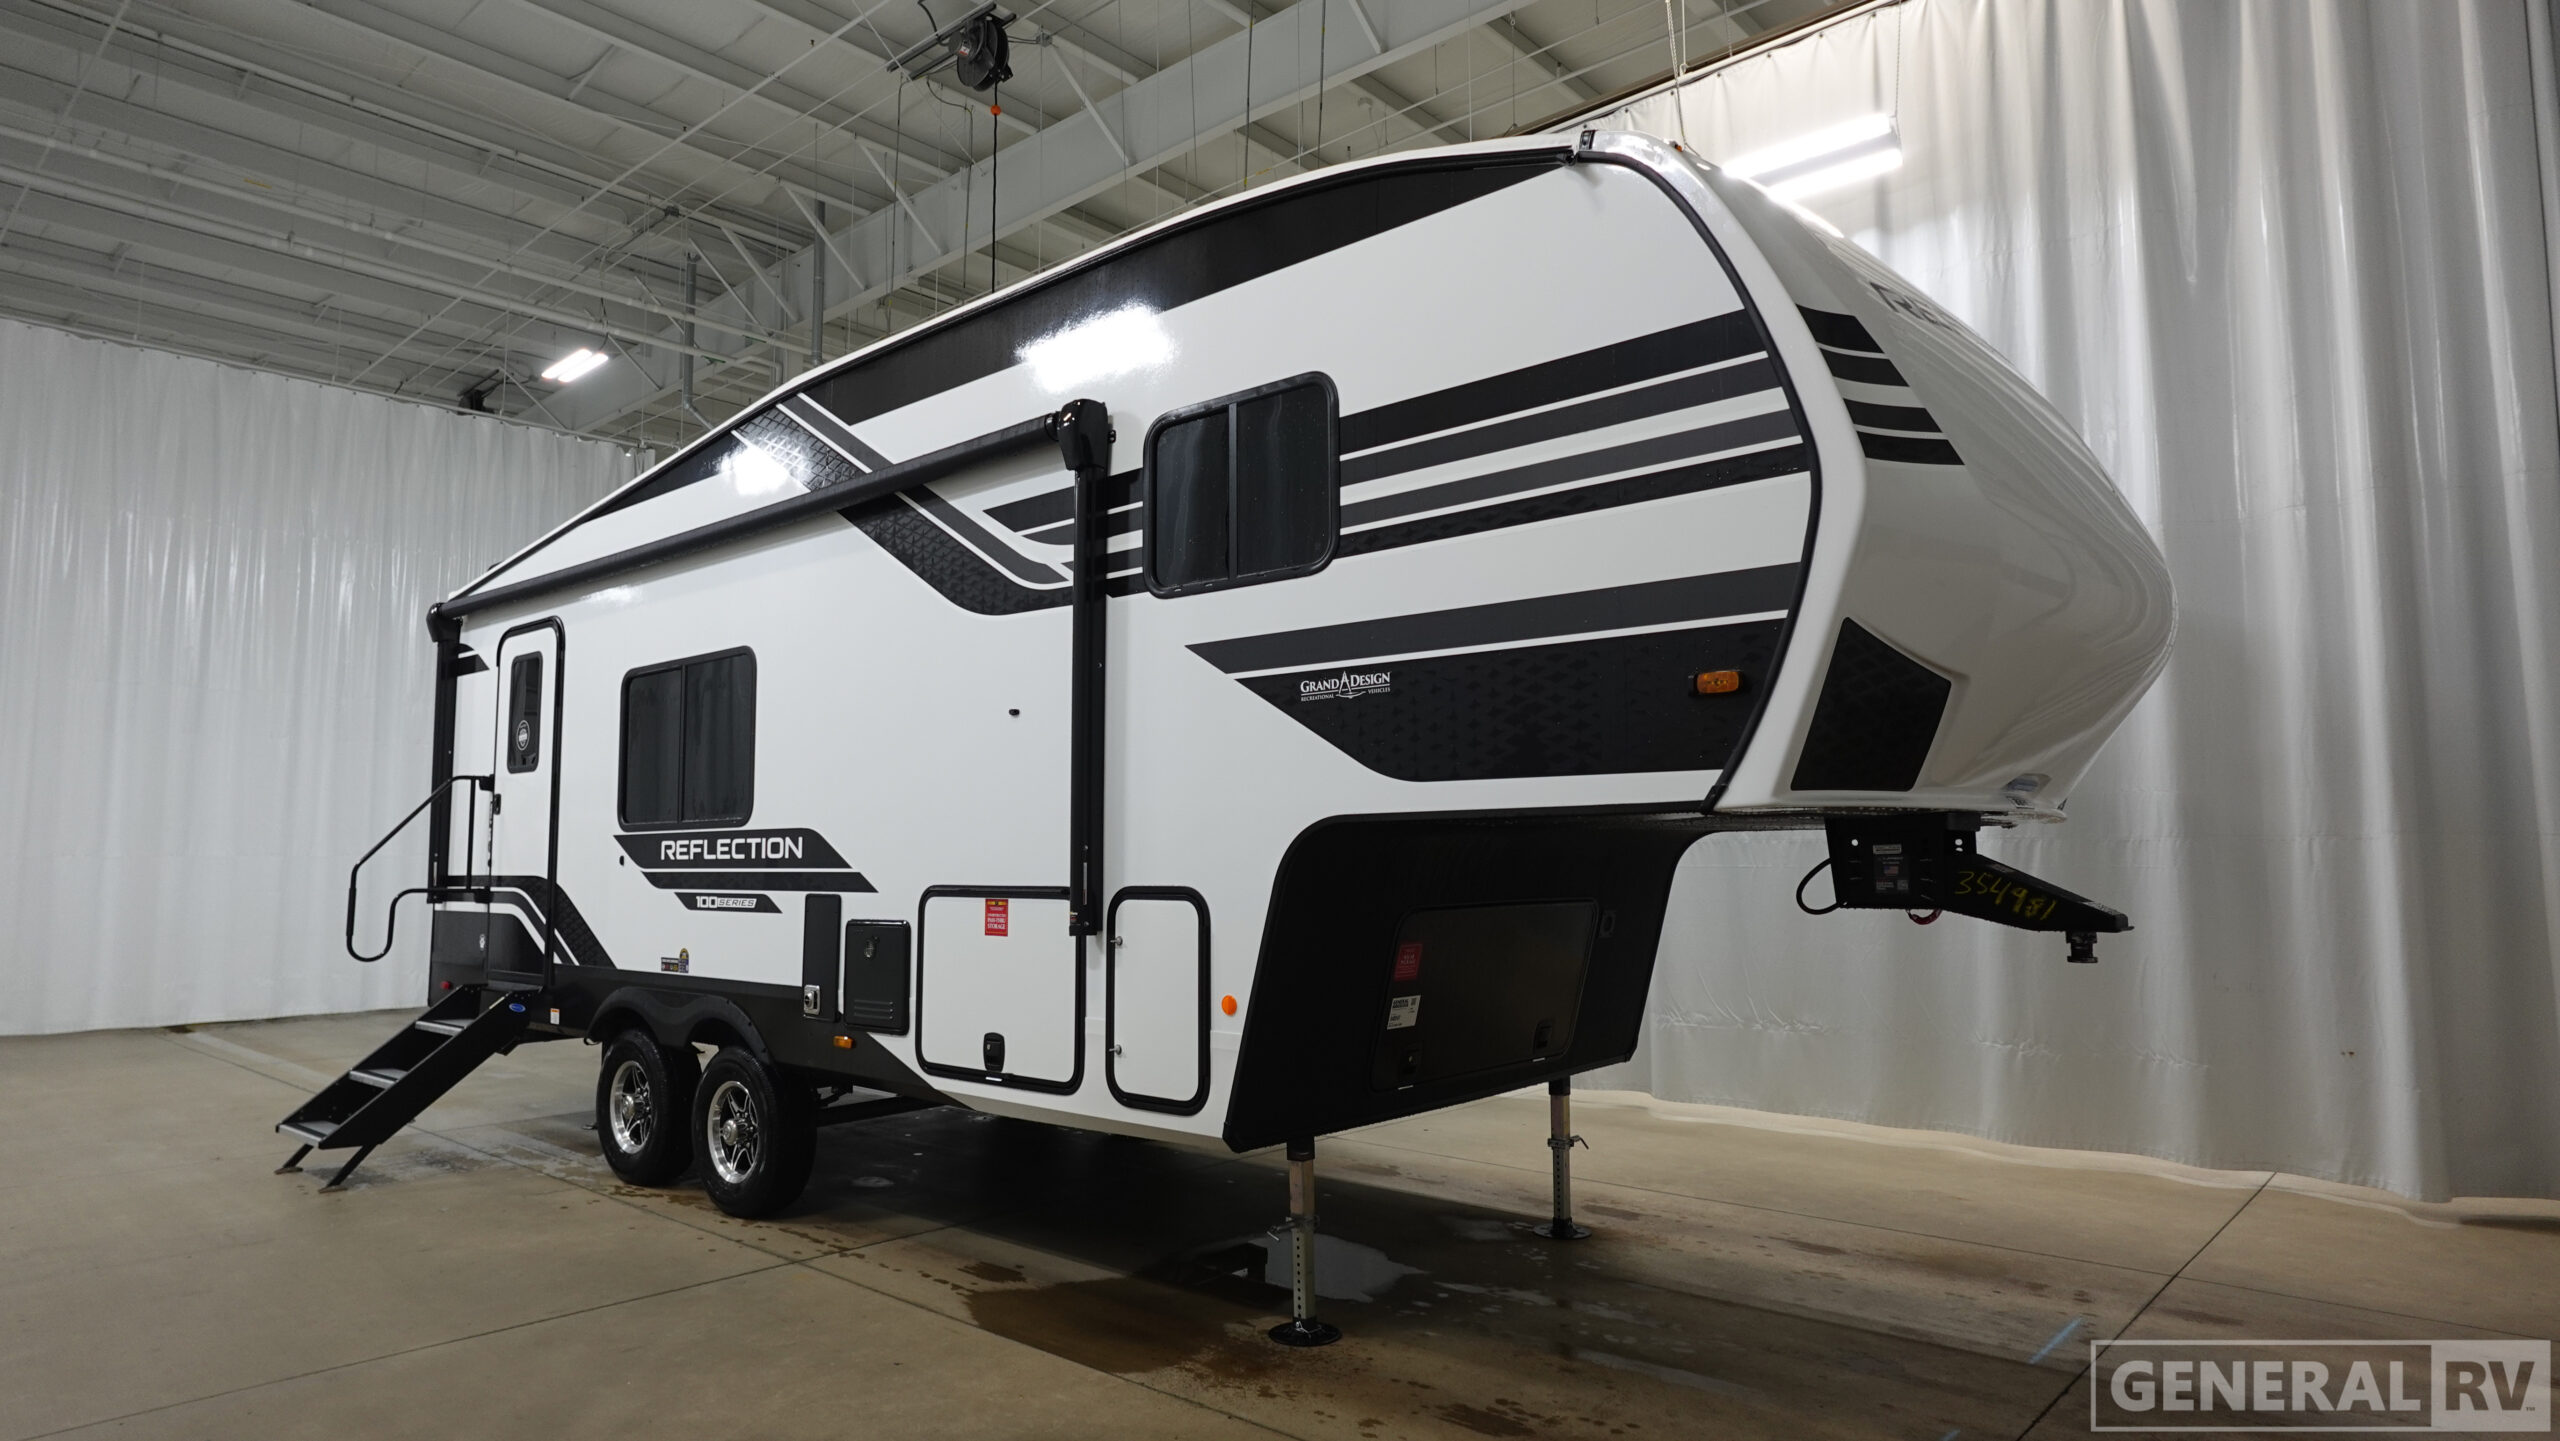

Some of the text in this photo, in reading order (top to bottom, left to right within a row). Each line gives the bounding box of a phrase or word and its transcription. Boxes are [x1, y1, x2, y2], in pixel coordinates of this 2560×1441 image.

[1300, 671, 1391, 693] GRAND DESIGN
[1301, 693, 1334, 701] RECREATIONAL
[660, 836, 804, 861] REFLECTION
[696, 896, 756, 909] 100 SERIES
